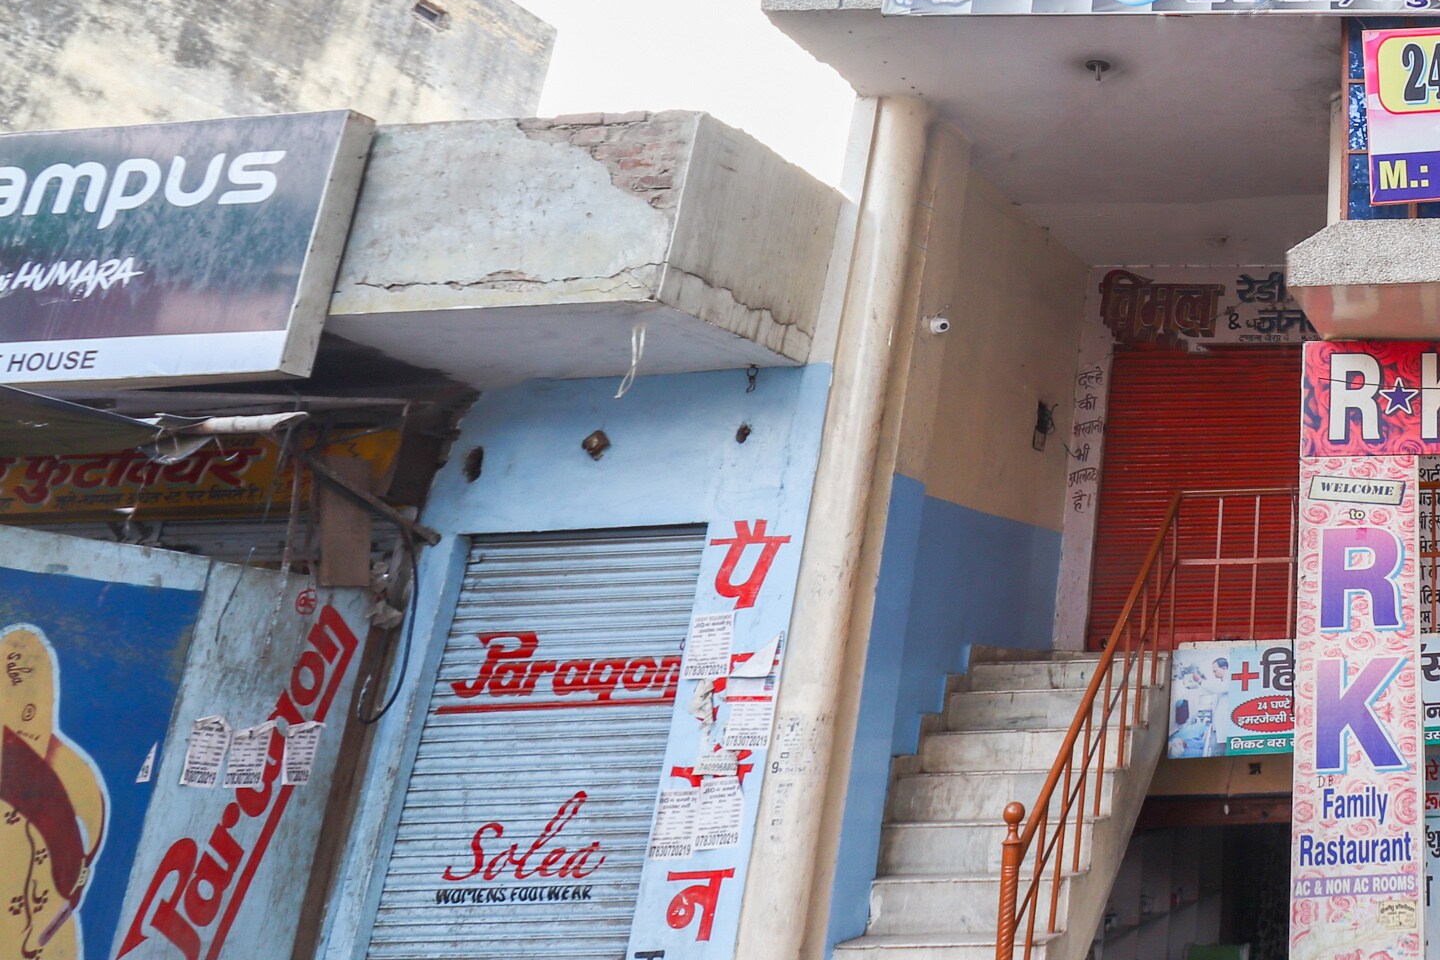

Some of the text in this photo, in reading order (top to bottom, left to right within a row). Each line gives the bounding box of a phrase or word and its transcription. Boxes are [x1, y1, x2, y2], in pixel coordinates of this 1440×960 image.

[11, 256, 144, 299] HUMARA
[6, 350, 99, 373] HOUSE
[1330, 352, 1382, 441] R
[1320, 480, 1395, 497] WELCOME
[1348, 508, 1366, 520] to
[1320, 527, 1403, 631] R
[450, 631, 684, 702] Paragon
[1314, 656, 1411, 773] K
[1322, 787, 1389, 826] Family
[442, 790, 605, 881] Solea
[1299, 833, 1412, 868] Rastaurant
[436, 884, 592, 905] WOMENS FOOTWEAR
[1295, 876, 1415, 897] AC & NON AC ROOMS
